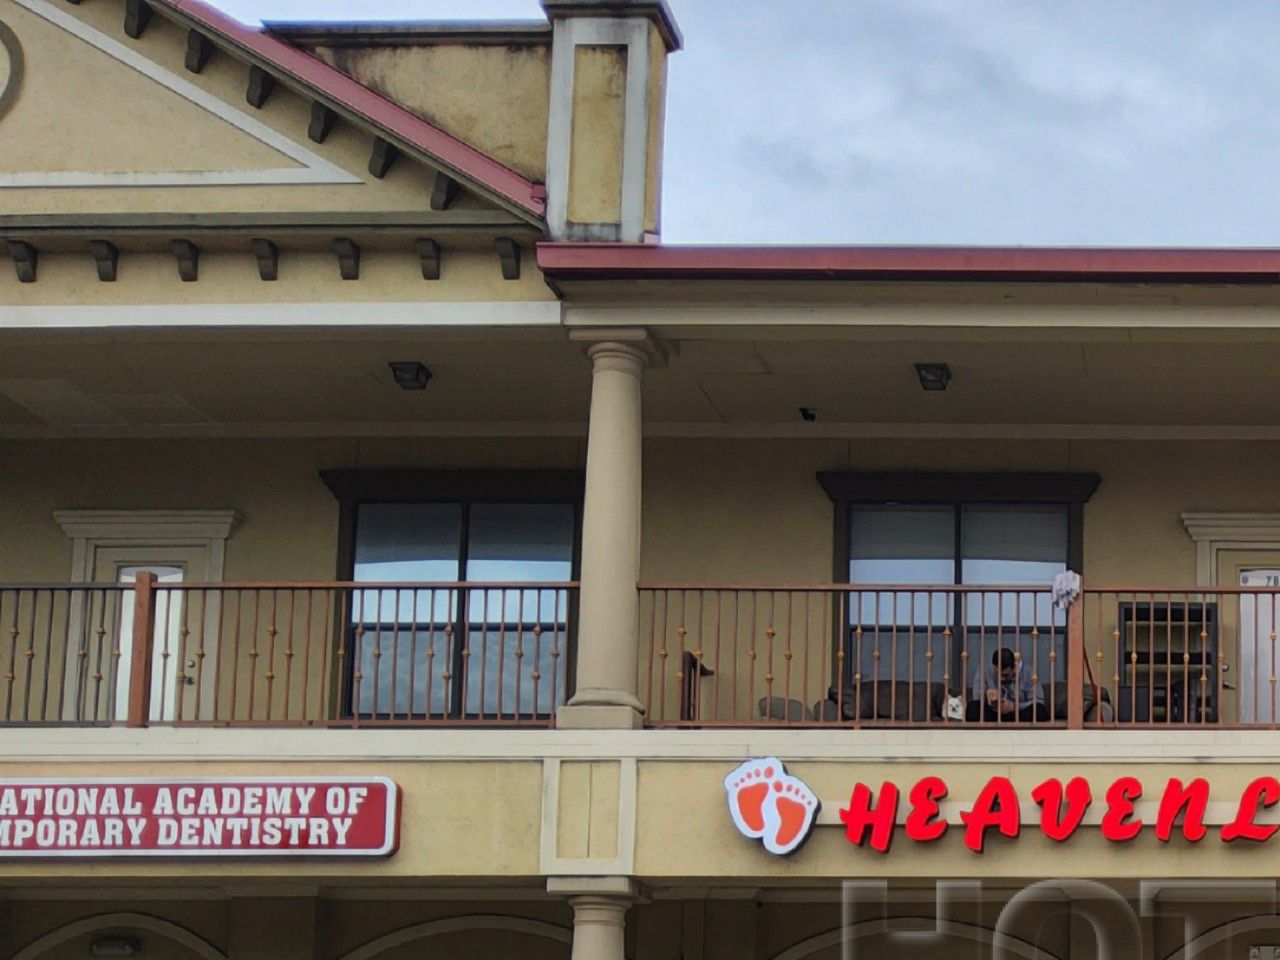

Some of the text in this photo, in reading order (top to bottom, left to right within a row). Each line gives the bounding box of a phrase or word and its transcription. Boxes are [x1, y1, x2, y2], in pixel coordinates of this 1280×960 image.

[0, 787, 368, 816] ATIONAL ACADEMY OF
[157, 817, 353, 846] DENTISTRY
